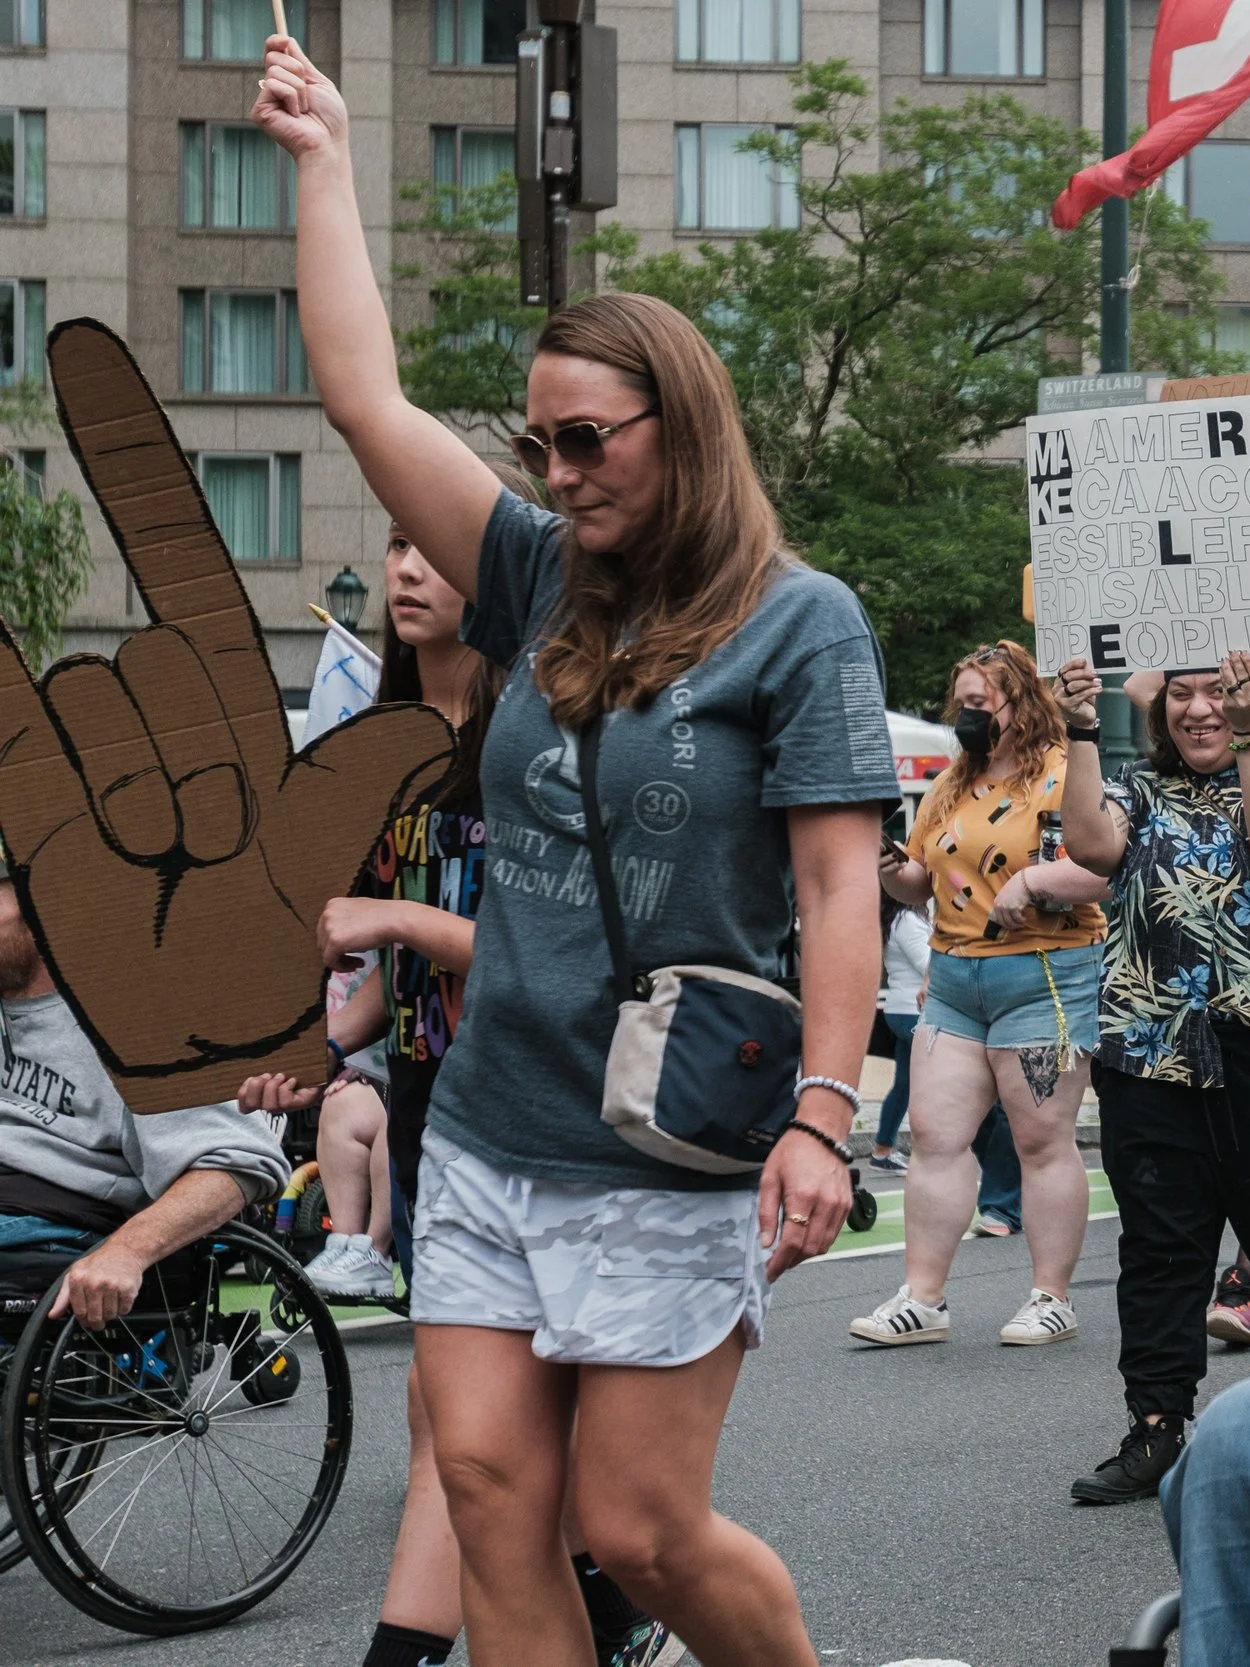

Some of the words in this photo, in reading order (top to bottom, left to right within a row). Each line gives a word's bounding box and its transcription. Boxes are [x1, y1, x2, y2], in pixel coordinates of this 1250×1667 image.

[1045, 375, 1143, 395] SWITZERLAND
[644, 790, 680, 816] 30
[489, 818, 555, 858] UNITY
[491, 858, 558, 898] ATION
[1, 1053, 77, 1119] STATE
